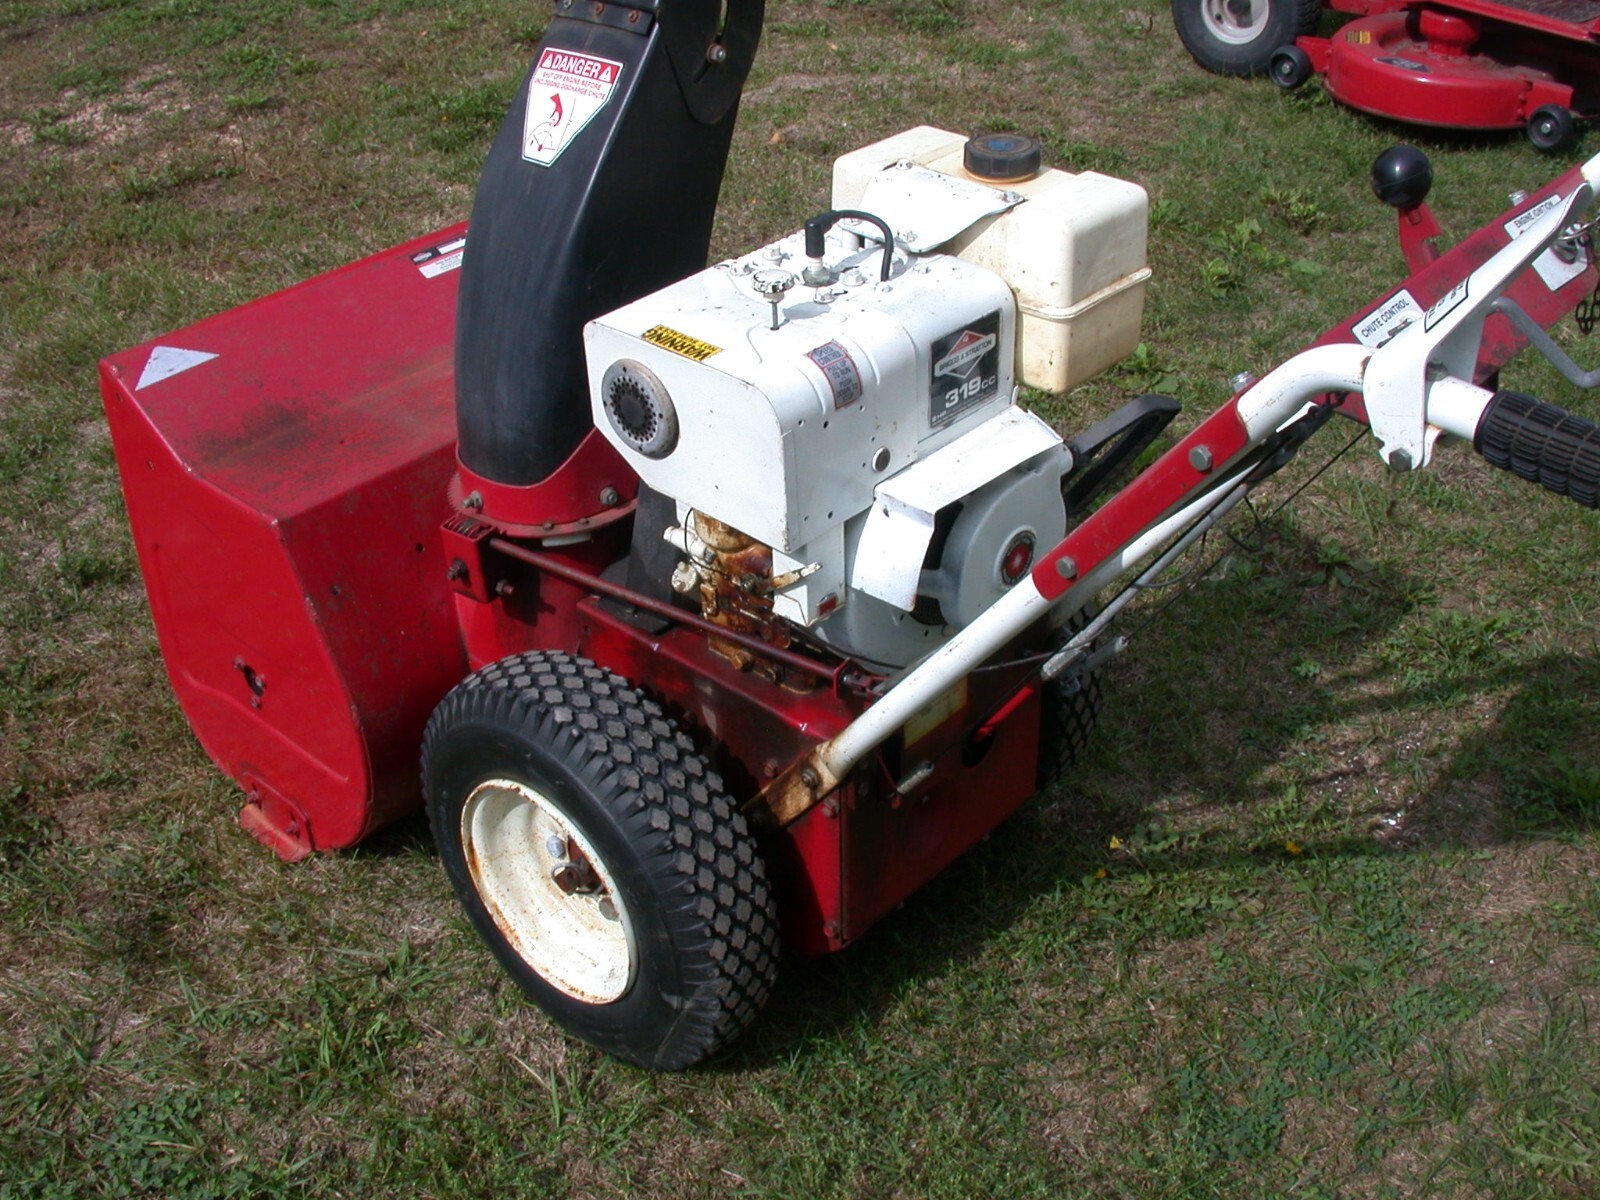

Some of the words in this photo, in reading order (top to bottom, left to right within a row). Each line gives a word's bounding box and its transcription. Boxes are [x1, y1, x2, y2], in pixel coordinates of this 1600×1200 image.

[551, 54, 601, 78] DANGER
[580, 80, 602, 91] BEFORE
[1513, 212, 1534, 228] ENGINE
[1361, 318, 1383, 338] CHUTE
[1381, 298, 1410, 322] CONTROL
[641, 327, 711, 361] WARNING
[939, 355, 960, 372] BRIGGS
[964, 337, 993, 358] STRATTON
